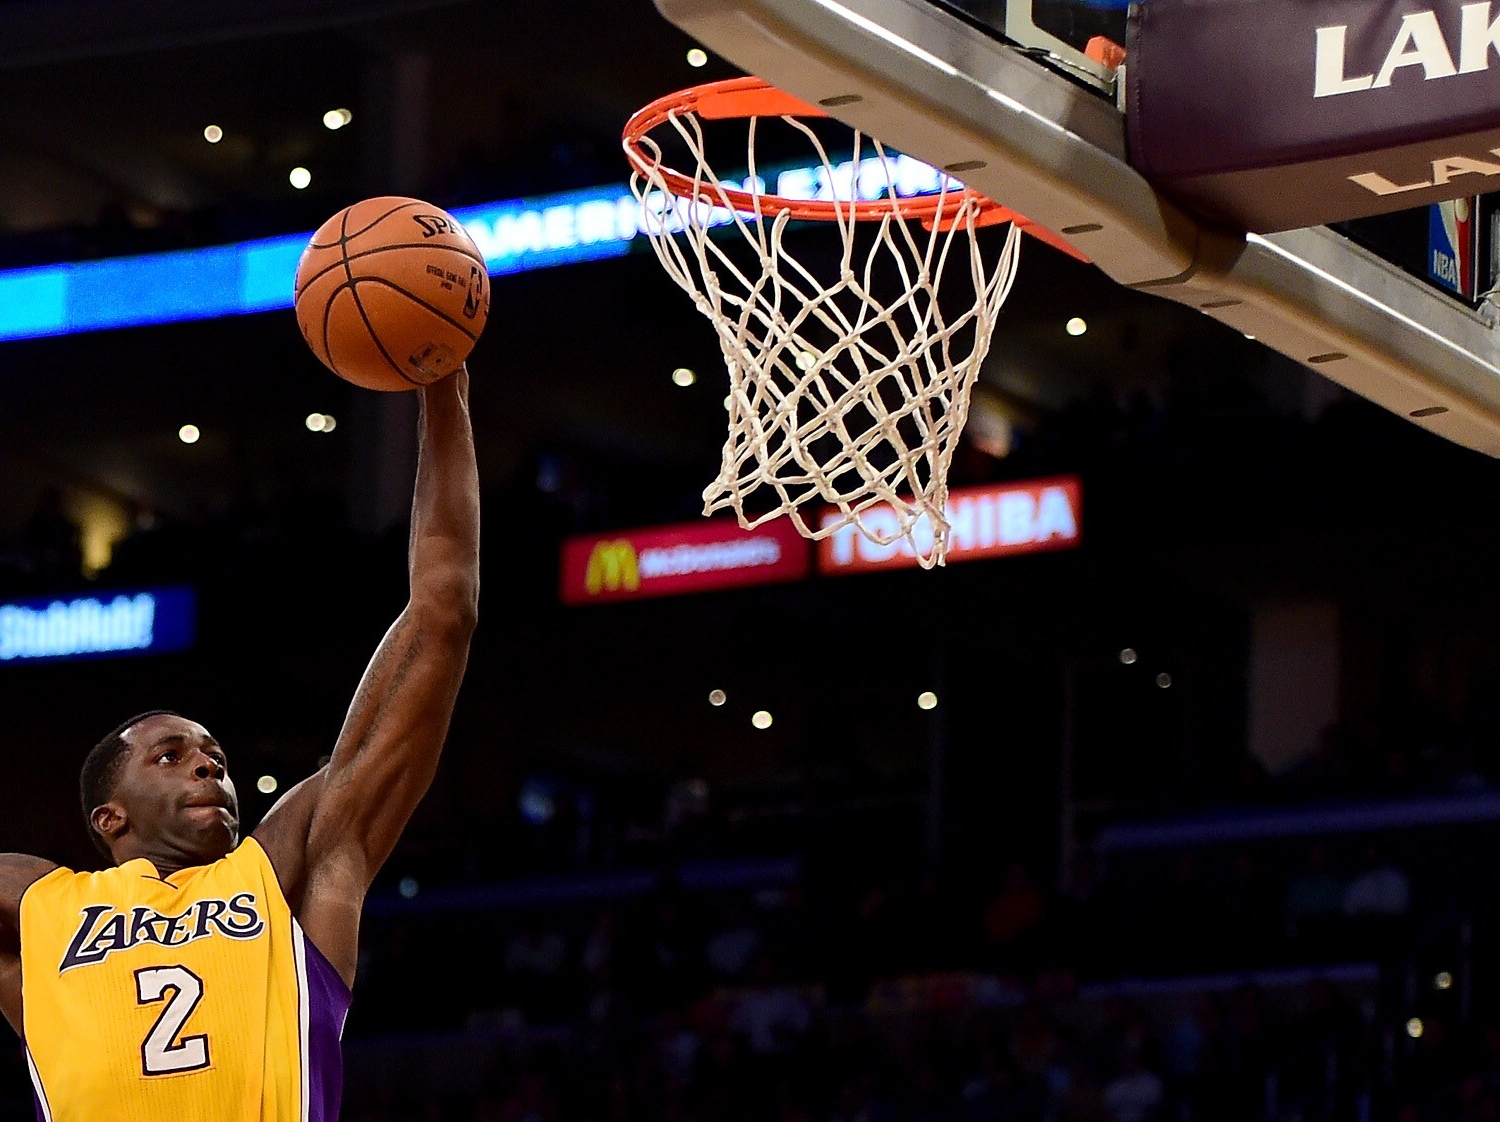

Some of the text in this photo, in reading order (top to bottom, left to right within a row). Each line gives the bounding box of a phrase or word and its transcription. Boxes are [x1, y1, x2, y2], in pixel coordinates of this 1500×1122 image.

[1347, 147, 1500, 196] LA
[1433, 248, 1456, 285] NBA
[58, 893, 265, 977] LAKERS
[133, 964, 210, 1076] 2
